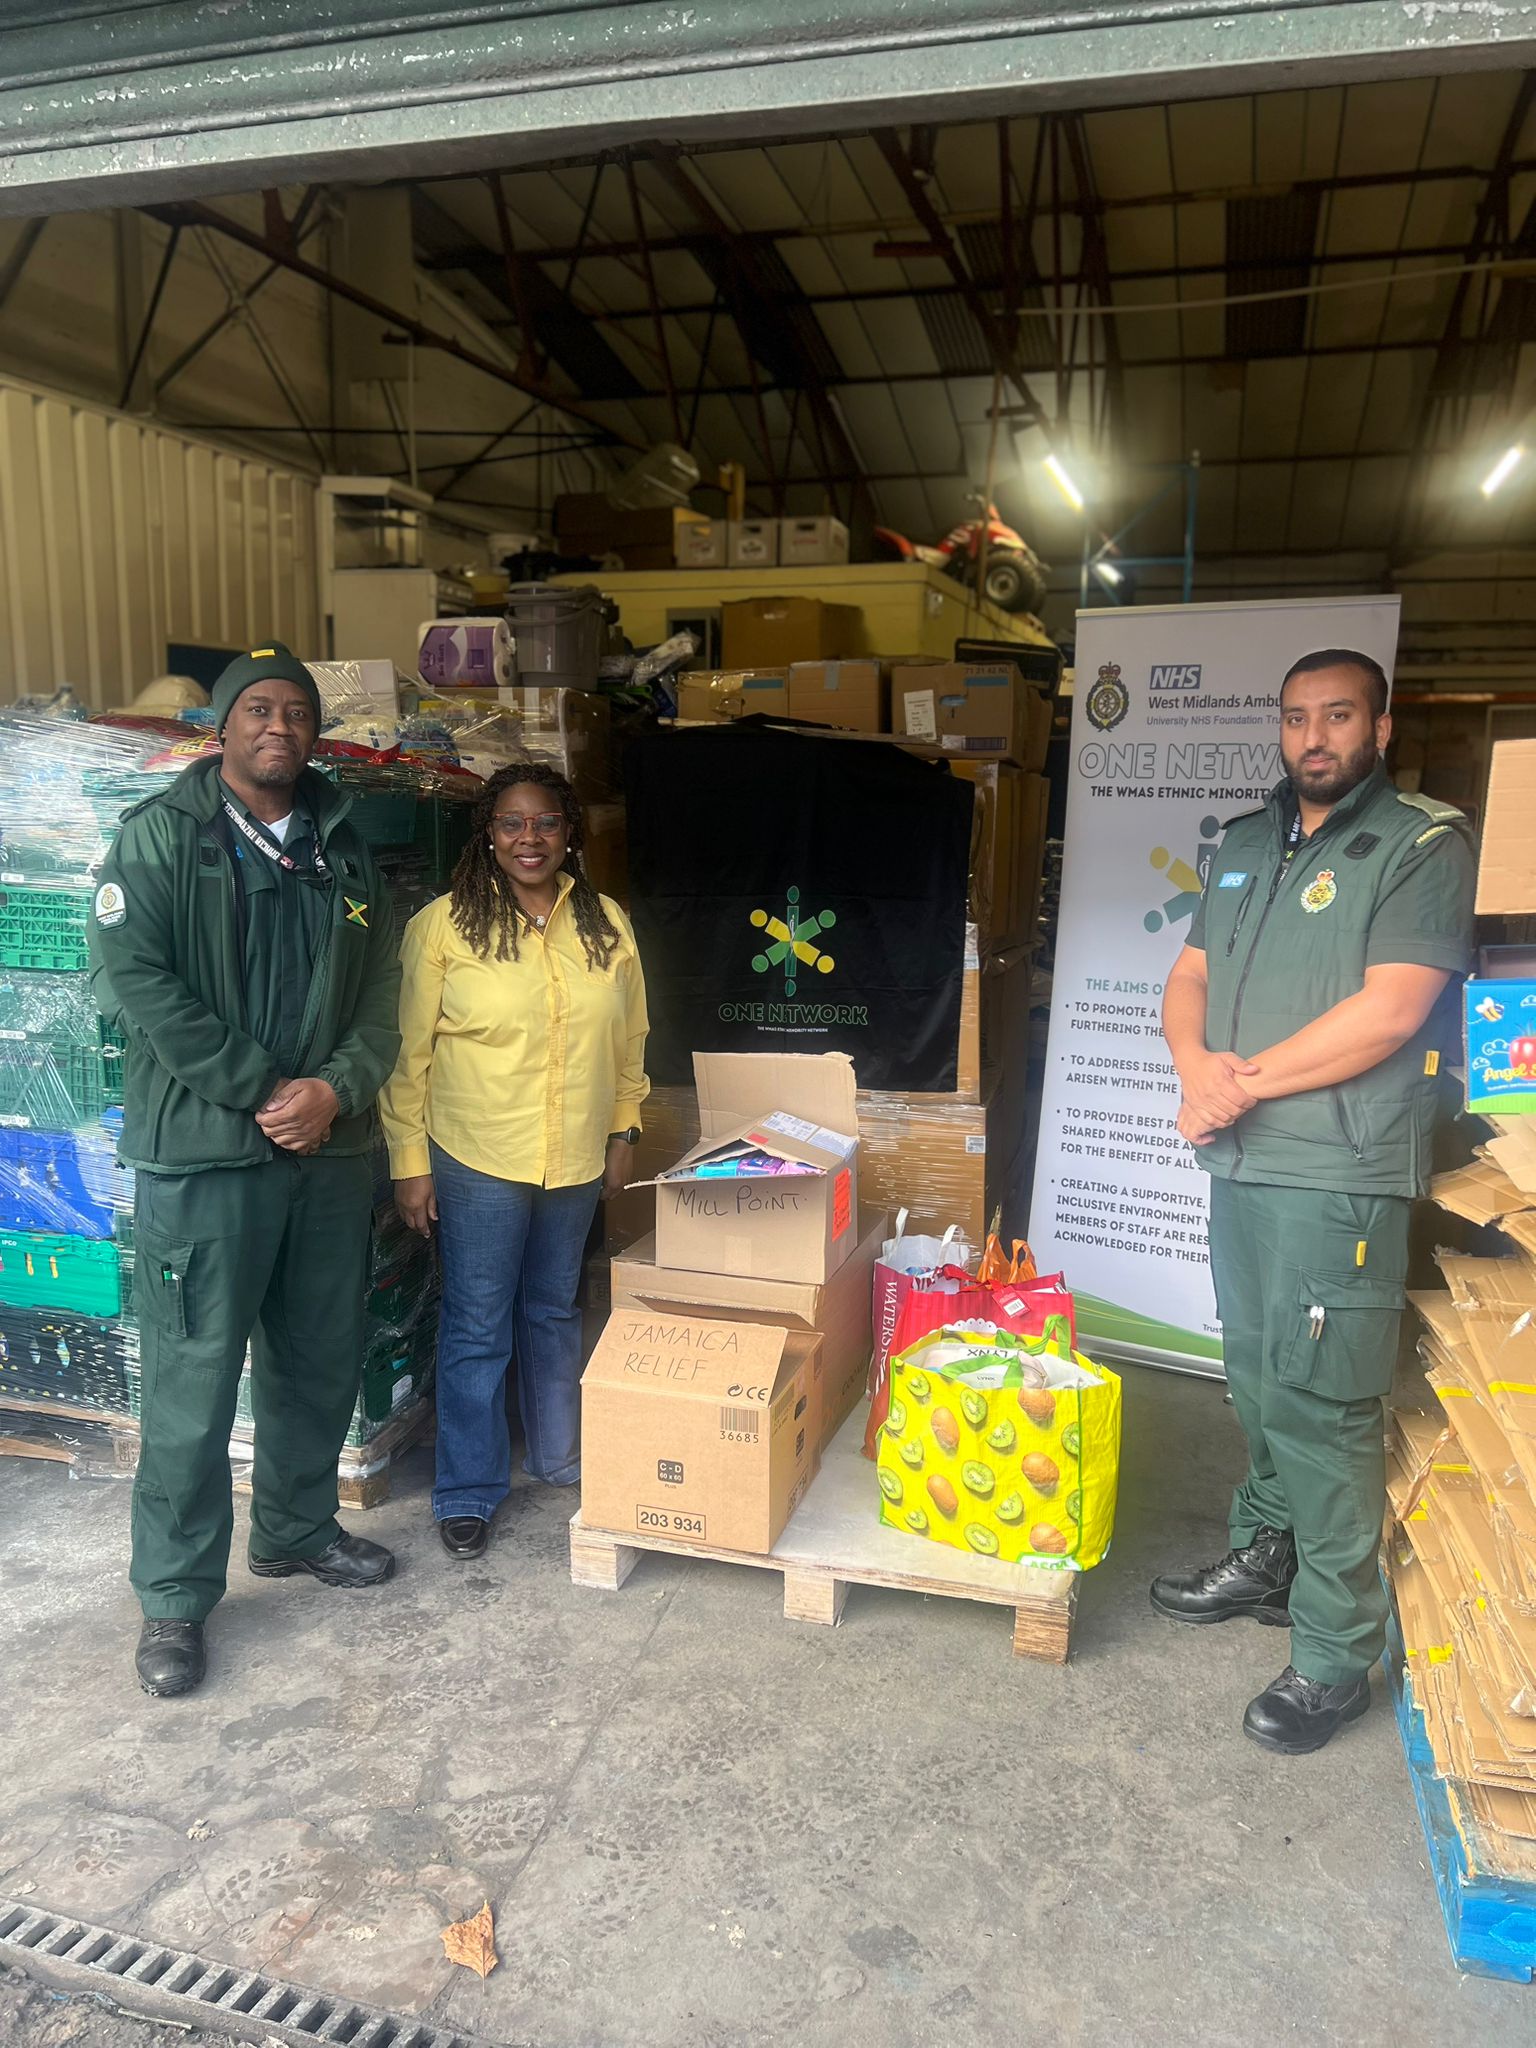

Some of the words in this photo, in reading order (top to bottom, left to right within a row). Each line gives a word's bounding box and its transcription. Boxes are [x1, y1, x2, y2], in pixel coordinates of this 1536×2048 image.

[1151, 666, 1200, 689] NHS
[1148, 696, 1179, 709] West
[1183, 695, 1241, 709] Midlands
[1147, 716, 1188, 727] University
[1190, 716, 1211, 725] NHS
[1214, 715, 1264, 725] Foundation
[1078, 742, 1157, 779] ONE
[1091, 786, 1113, 797] THE
[1117, 786, 1154, 798] WMAS
[1158, 787, 1205, 799] ETHNIC
[1208, 787, 1270, 800] MINORIT
[1220, 873, 1246, 887] NHS
[1086, 978, 1110, 991] THE
[1113, 980, 1149, 994] AIMS
[1152, 983, 1165, 996] O
[718, 1002, 764, 1022] ONE
[1075, 1001, 1090, 1012] TO
[1093, 1003, 1147, 1018] PROMOTE
[1149, 1008, 1157, 1018] A
[1070, 1019, 1141, 1035] FURTHERING
[1144, 1025, 1164, 1037] THE
[1070, 1054, 1085, 1065] TO
[1087, 1056, 1140, 1071] ADDRESS
[1142, 1062, 1180, 1076] ISSUE
[1066, 1072, 1108, 1086] ARISEN
[1110, 1076, 1154, 1091] WITHIN
[1156, 1081, 1178, 1094] THE
[1066, 1107, 1081, 1118] TO
[1083, 1109, 1134, 1125] PROVIDE
[1136, 1116, 1164, 1129] BEST
[1062, 1125, 1106, 1139] SHARED
[1109, 1130, 1180, 1149] KNOWLEDGE
[1061, 1142, 1083, 1154] FOR
[1085, 1145, 1106, 1157] THE
[1108, 1148, 1154, 1164] BENEFIT
[1156, 1155, 1172, 1166] OF
[1174, 1157, 1195, 1170] ALL
[1061, 1178, 1118, 1195] CREATING
[1120, 1186, 1129, 1197] A
[1056, 1194, 1116, 1213] INCLUSIVE
[1119, 1203, 1202, 1226] ENVIRONMENT
[1055, 1212, 1107, 1229] MEMBERS
[1109, 1220, 1125, 1231] OF
[1127, 1223, 1161, 1237] STAFF
[1163, 1229, 1186, 1242] ARE
[1054, 1229, 1147, 1253] ACKNOWLEDGED
[1149, 1244, 1172, 1258] FOR
[1175, 1249, 1209, 1264] THEIR
[623, 1323, 738, 1354] JAMAICA
[623, 1351, 709, 1384] RELIEF
[719, 1430, 760, 1444] 36685
[659, 1462, 667, 1471] C
[674, 1464, 682, 1473] D
[640, 1511, 669, 1528] 203
[673, 1516, 702, 1533] 934
